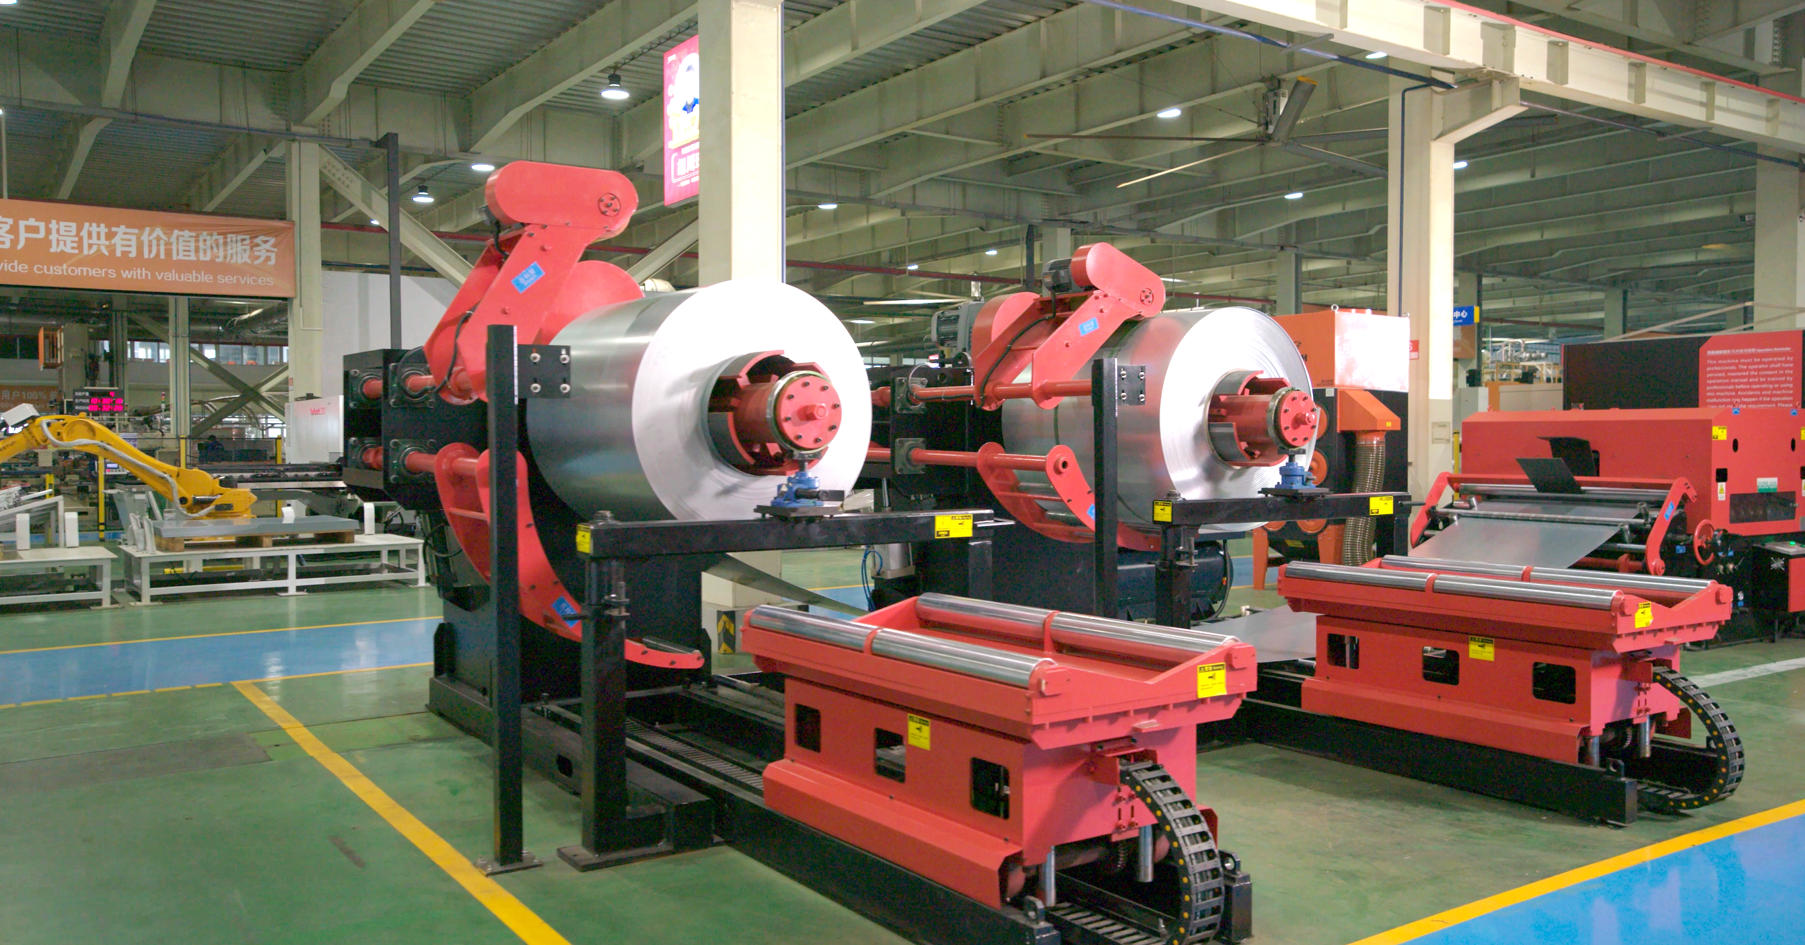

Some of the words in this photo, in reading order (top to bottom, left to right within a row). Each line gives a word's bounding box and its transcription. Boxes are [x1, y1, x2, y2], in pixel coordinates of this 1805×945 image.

[33, 264, 117, 279] customers
[120, 267, 151, 280] with
[156, 269, 213, 284] valuable
[217, 273, 275, 287] services
